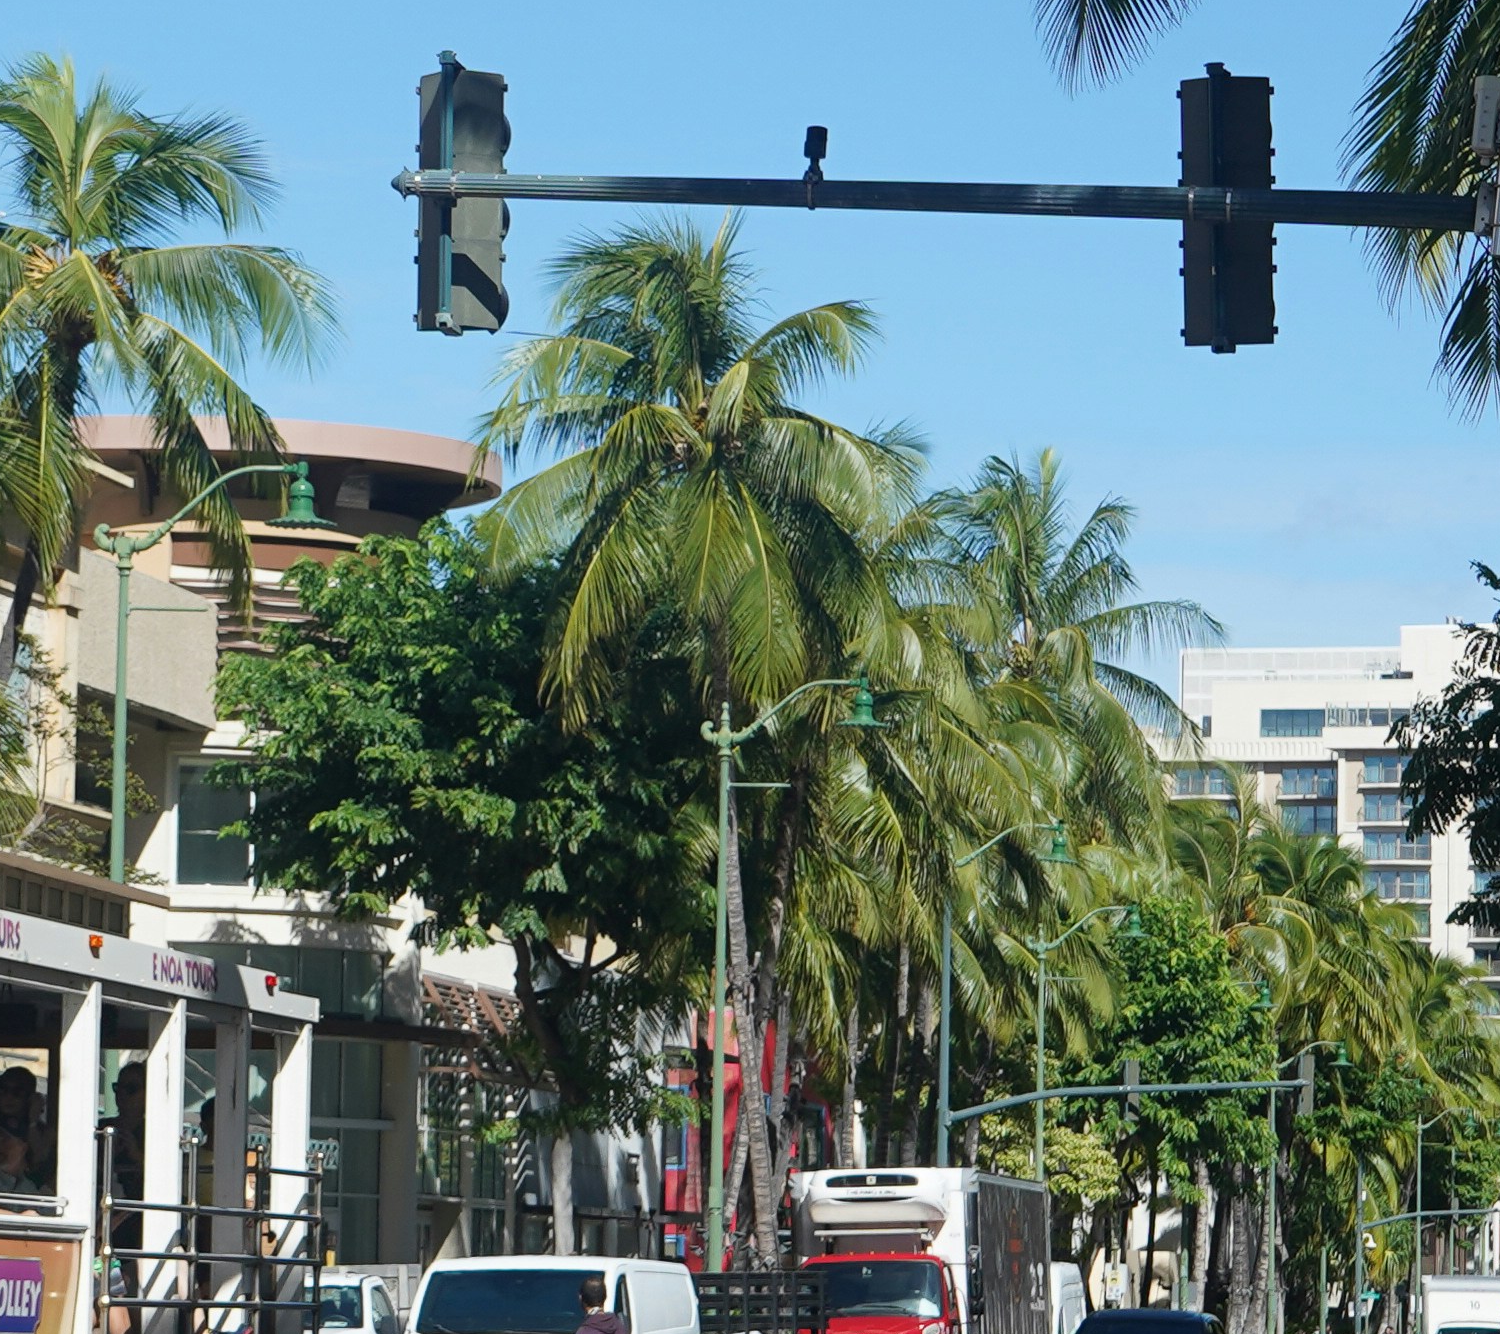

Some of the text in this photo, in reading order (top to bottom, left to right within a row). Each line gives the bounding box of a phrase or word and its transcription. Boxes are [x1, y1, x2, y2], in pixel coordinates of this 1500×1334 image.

[161, 955, 184, 985] NOA
[185, 959, 218, 993] TOURS
[1470, 1301, 1481, 1310] 10
